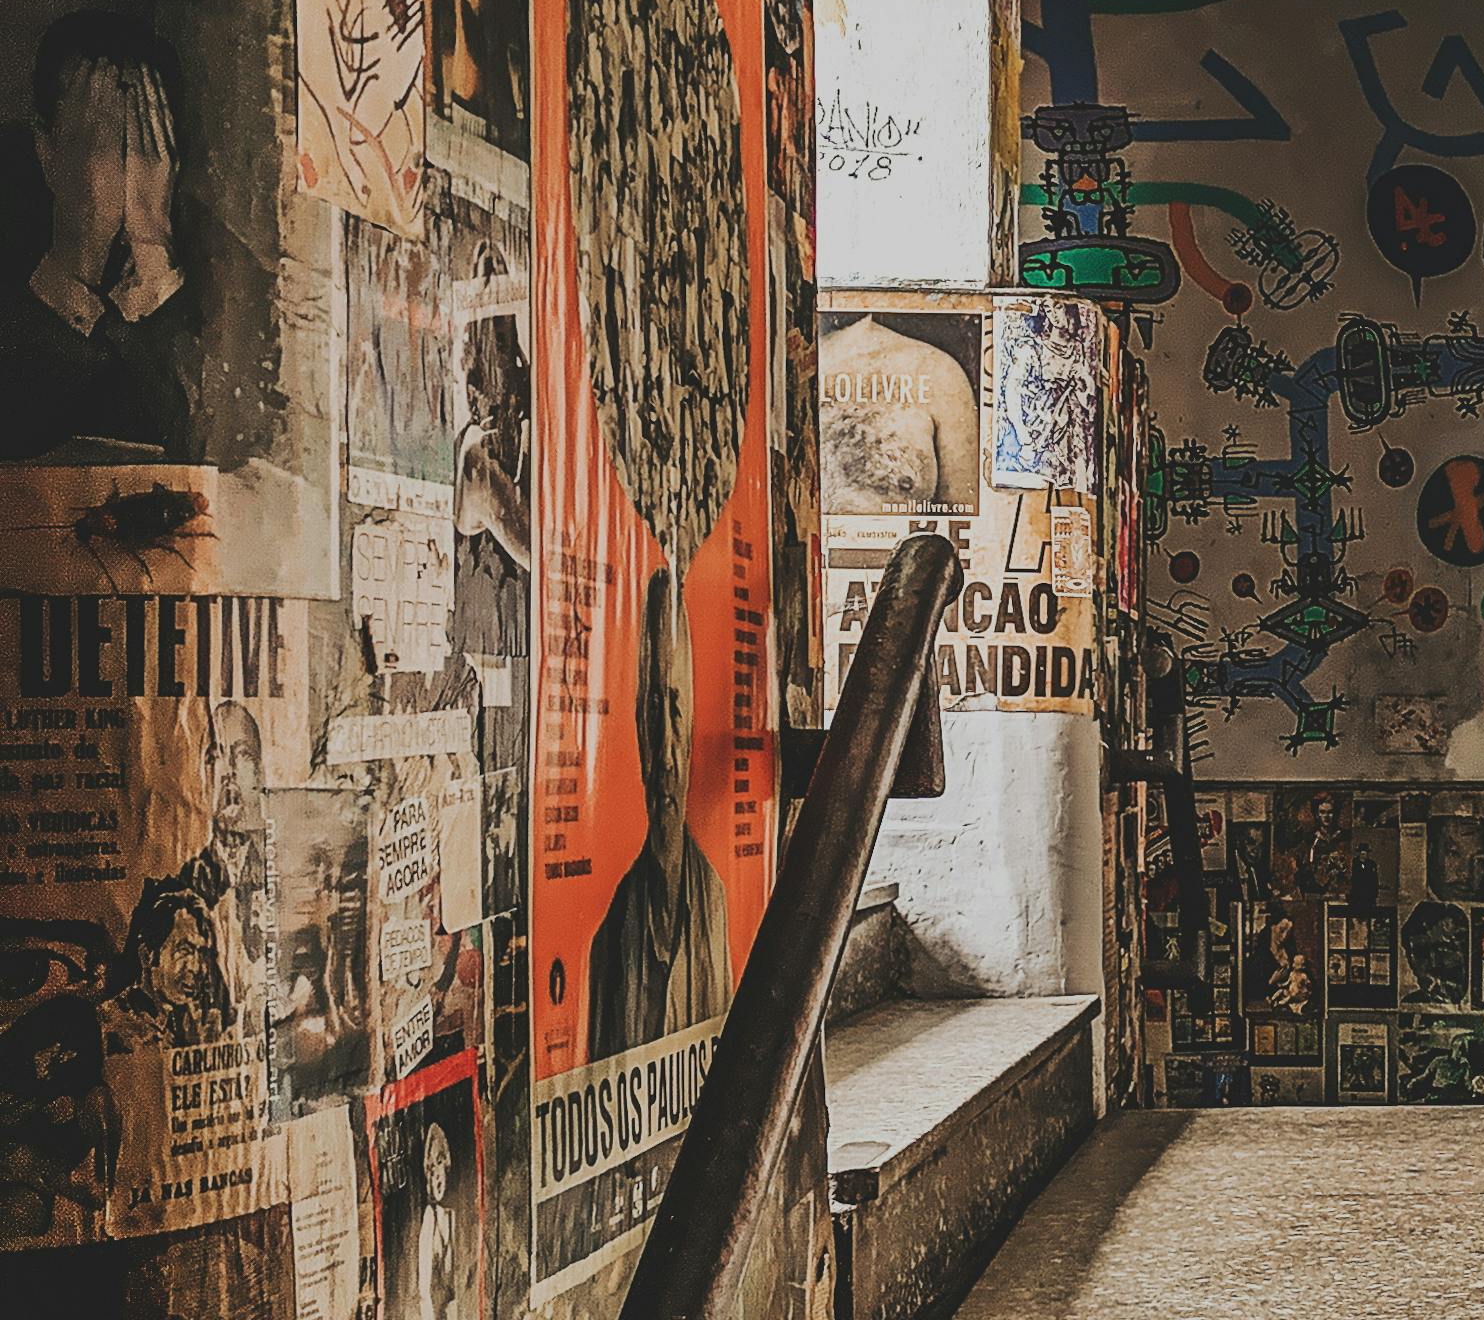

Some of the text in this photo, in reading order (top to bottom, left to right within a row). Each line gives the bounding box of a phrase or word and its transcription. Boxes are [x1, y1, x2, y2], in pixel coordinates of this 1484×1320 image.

[839, 577, 1059, 639] AÇÃO
[18, 595, 286, 698] DETETIVE
[394, 801, 427, 833] PARA
[386, 857, 429, 898] AGORA
[395, 1003, 431, 1049] ENTRE
[400, 1029, 431, 1074] AMOR
[171, 1082, 202, 1112] ELE
[535, 1078, 614, 1188] TODOS
[617, 1066, 642, 1152] OS
[161, 1179, 193, 1201] NAS
